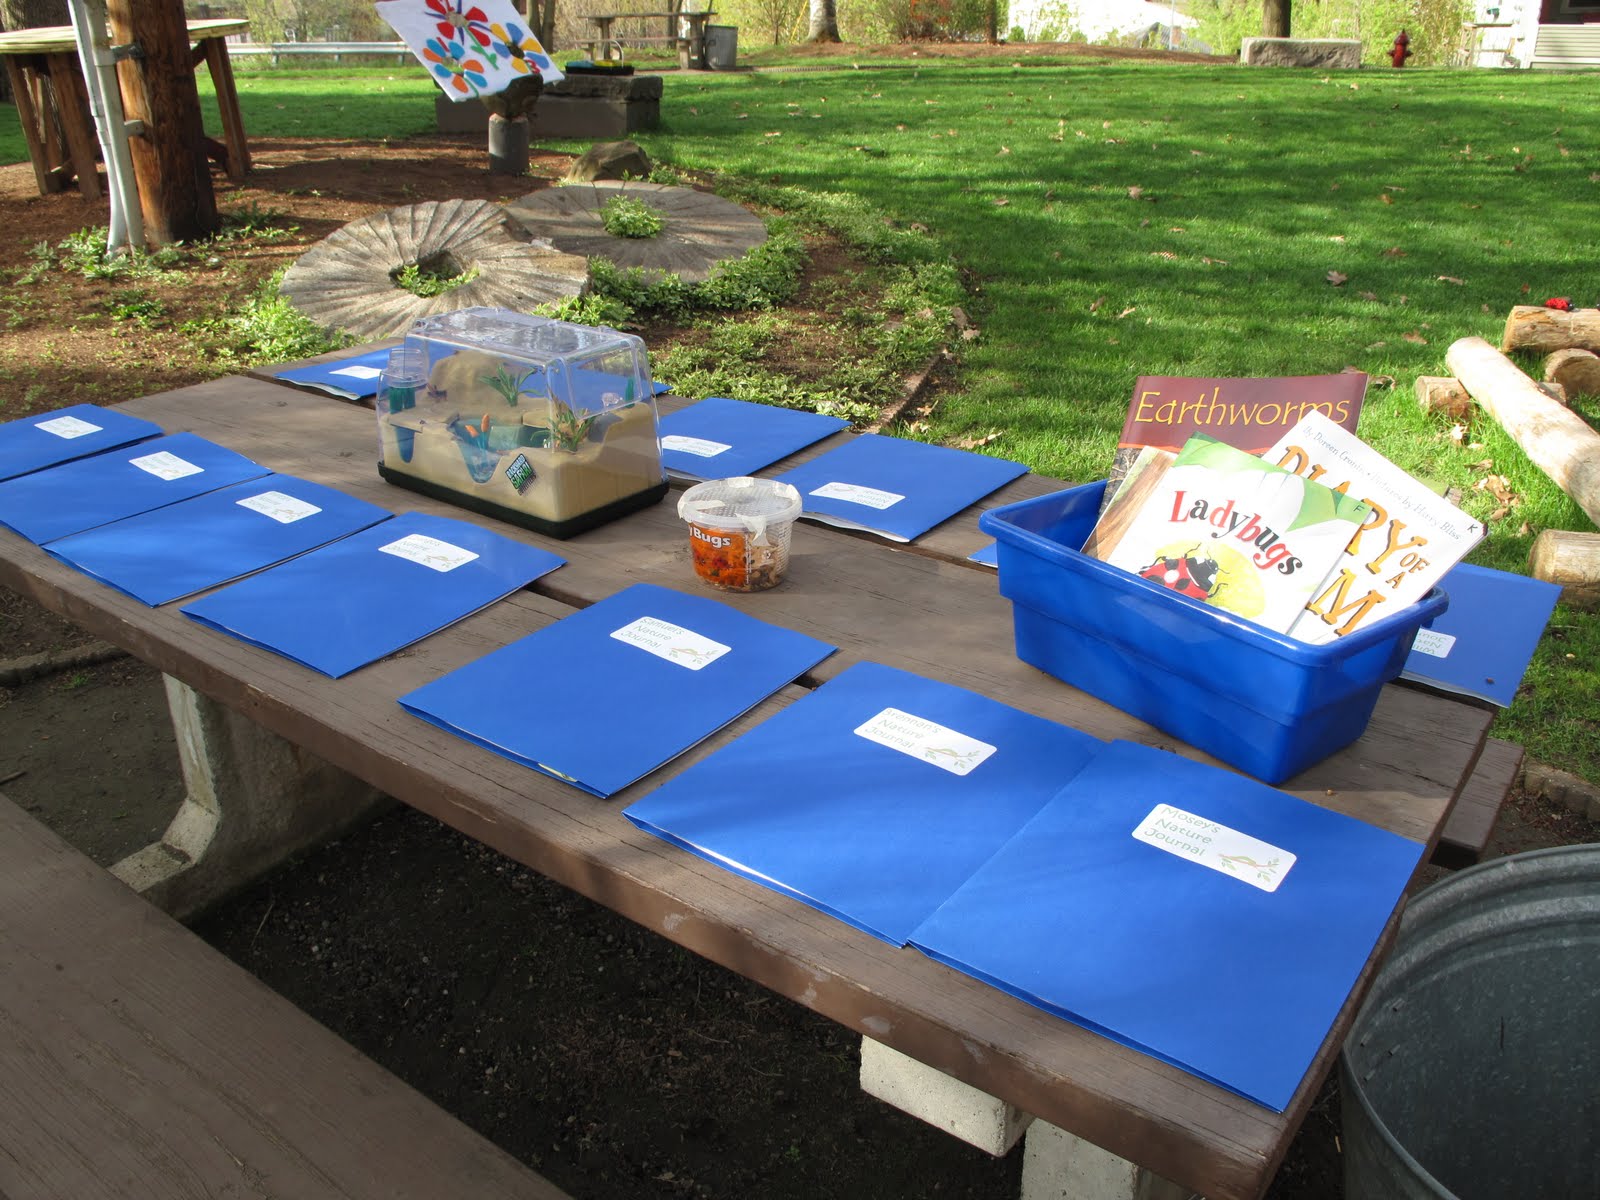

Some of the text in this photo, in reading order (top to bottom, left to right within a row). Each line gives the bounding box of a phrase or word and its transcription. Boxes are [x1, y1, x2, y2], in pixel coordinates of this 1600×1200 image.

[1135, 387, 1350, 426] Earthworms
[1313, 431, 1339, 456] Doreen
[1402, 496, 1412, 510] by
[1440, 521, 1461, 540] Bliss
[1276, 445, 1428, 575] DRY
[693, 527, 731, 549] Bugs
[1168, 490, 1303, 575] Ladybugs
[1467, 523, 1478, 534] K
[1400, 552, 1430, 574] OF
[1385, 571, 1406, 589] A
[621, 630, 662, 648] Journal
[634, 625, 672, 641] Nature
[878, 719, 924, 739] Nature
[882, 708, 941, 734] Brennan's
[865, 726, 915, 748] Journal
[1155, 818, 1212, 844] Nature
[1161, 806, 1222, 834] Mosey's
[1144, 827, 1206, 856] Journal
